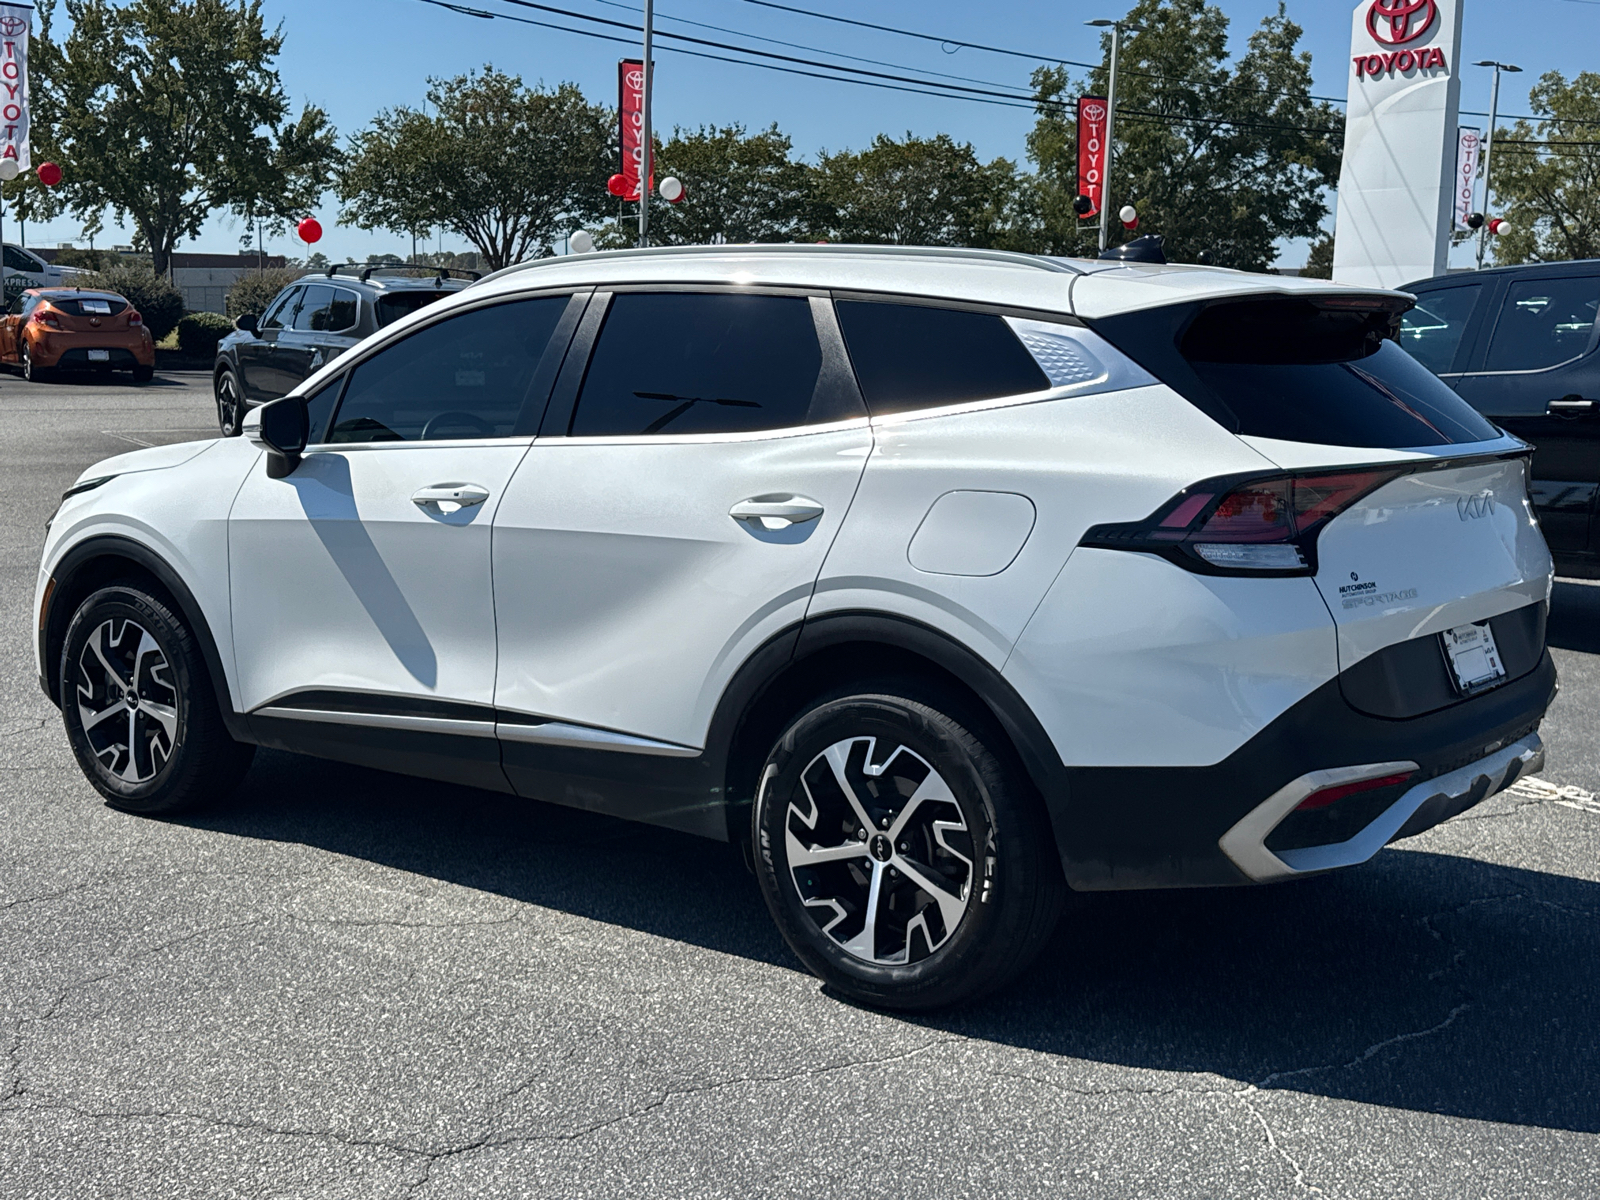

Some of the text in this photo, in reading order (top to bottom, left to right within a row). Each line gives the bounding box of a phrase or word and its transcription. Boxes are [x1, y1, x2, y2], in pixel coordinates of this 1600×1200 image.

[1353, 47, 1445, 77] TOYOTA
[3, 41, 21, 161] TOYOTA
[4, 278, 38, 286] XPRESS
[1457, 493, 1496, 522] KIA
[1338, 581, 1377, 593] HUTCHINSON
[1341, 588, 1419, 609] SPORTAGE
